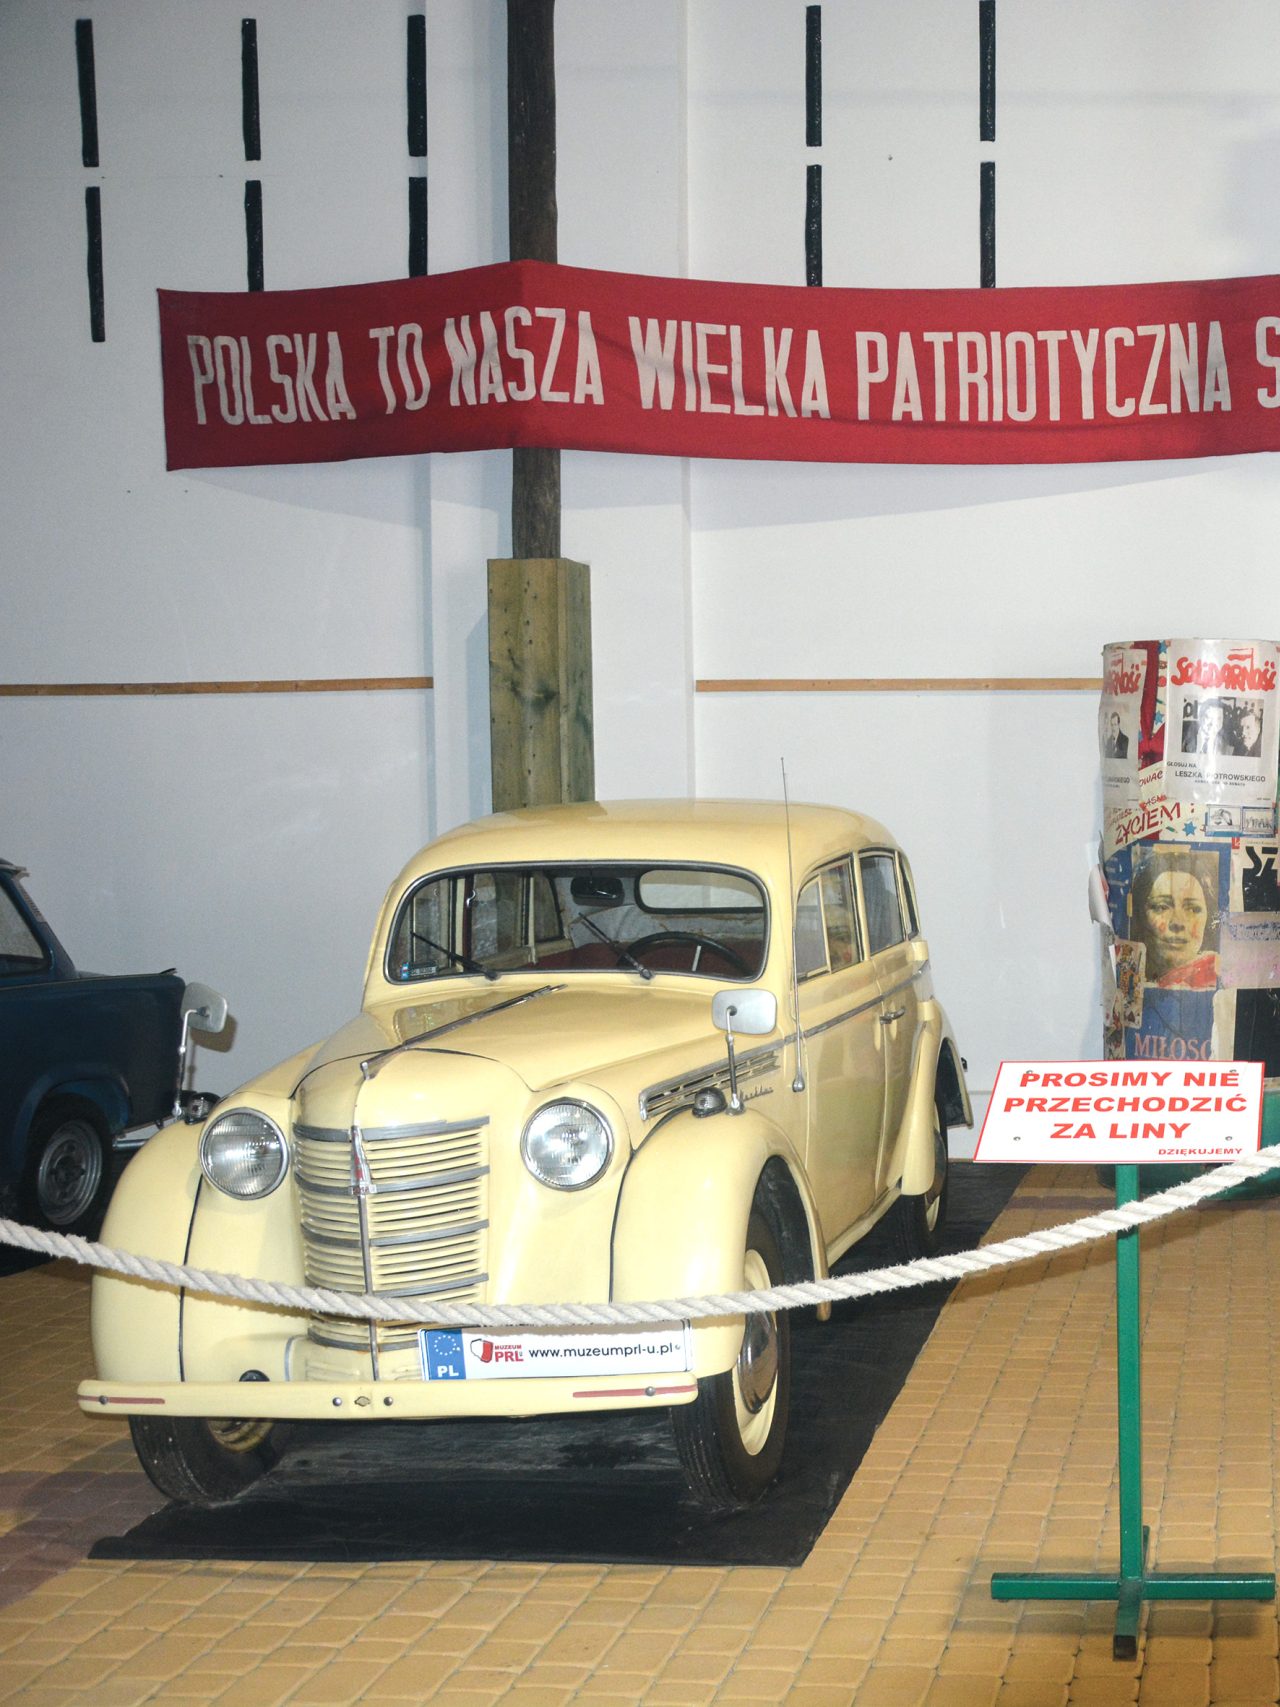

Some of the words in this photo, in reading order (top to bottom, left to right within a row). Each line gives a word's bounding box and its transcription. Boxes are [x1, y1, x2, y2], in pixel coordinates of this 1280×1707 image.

[187, 332, 356, 426] POLSKA
[369, 322, 431, 415] TO
[443, 306, 605, 406] NASZA
[628, 315, 831, 419] WIELKA
[855, 320, 1232, 422] PATRIOTYCZNA
[1174, 770, 1203, 779] LESZKA
[1206, 772, 1266, 783] POTROWSKIEGO
[1019, 1071, 1173, 1088] PROSIMY
[1183, 1072, 1240, 1087] NIE
[1003, 1093, 1248, 1113] PRZECHODZIĆ
[1050, 1122, 1097, 1139] ZA
[1109, 1122, 1192, 1139] LINY
[1158, 1147, 1243, 1157] DZIĘKUJEMY
[494, 1350, 524, 1362] PRL
[528, 1342, 674, 1359] www.muzeumprl-u.pl
[437, 1365, 459, 1378] PL
